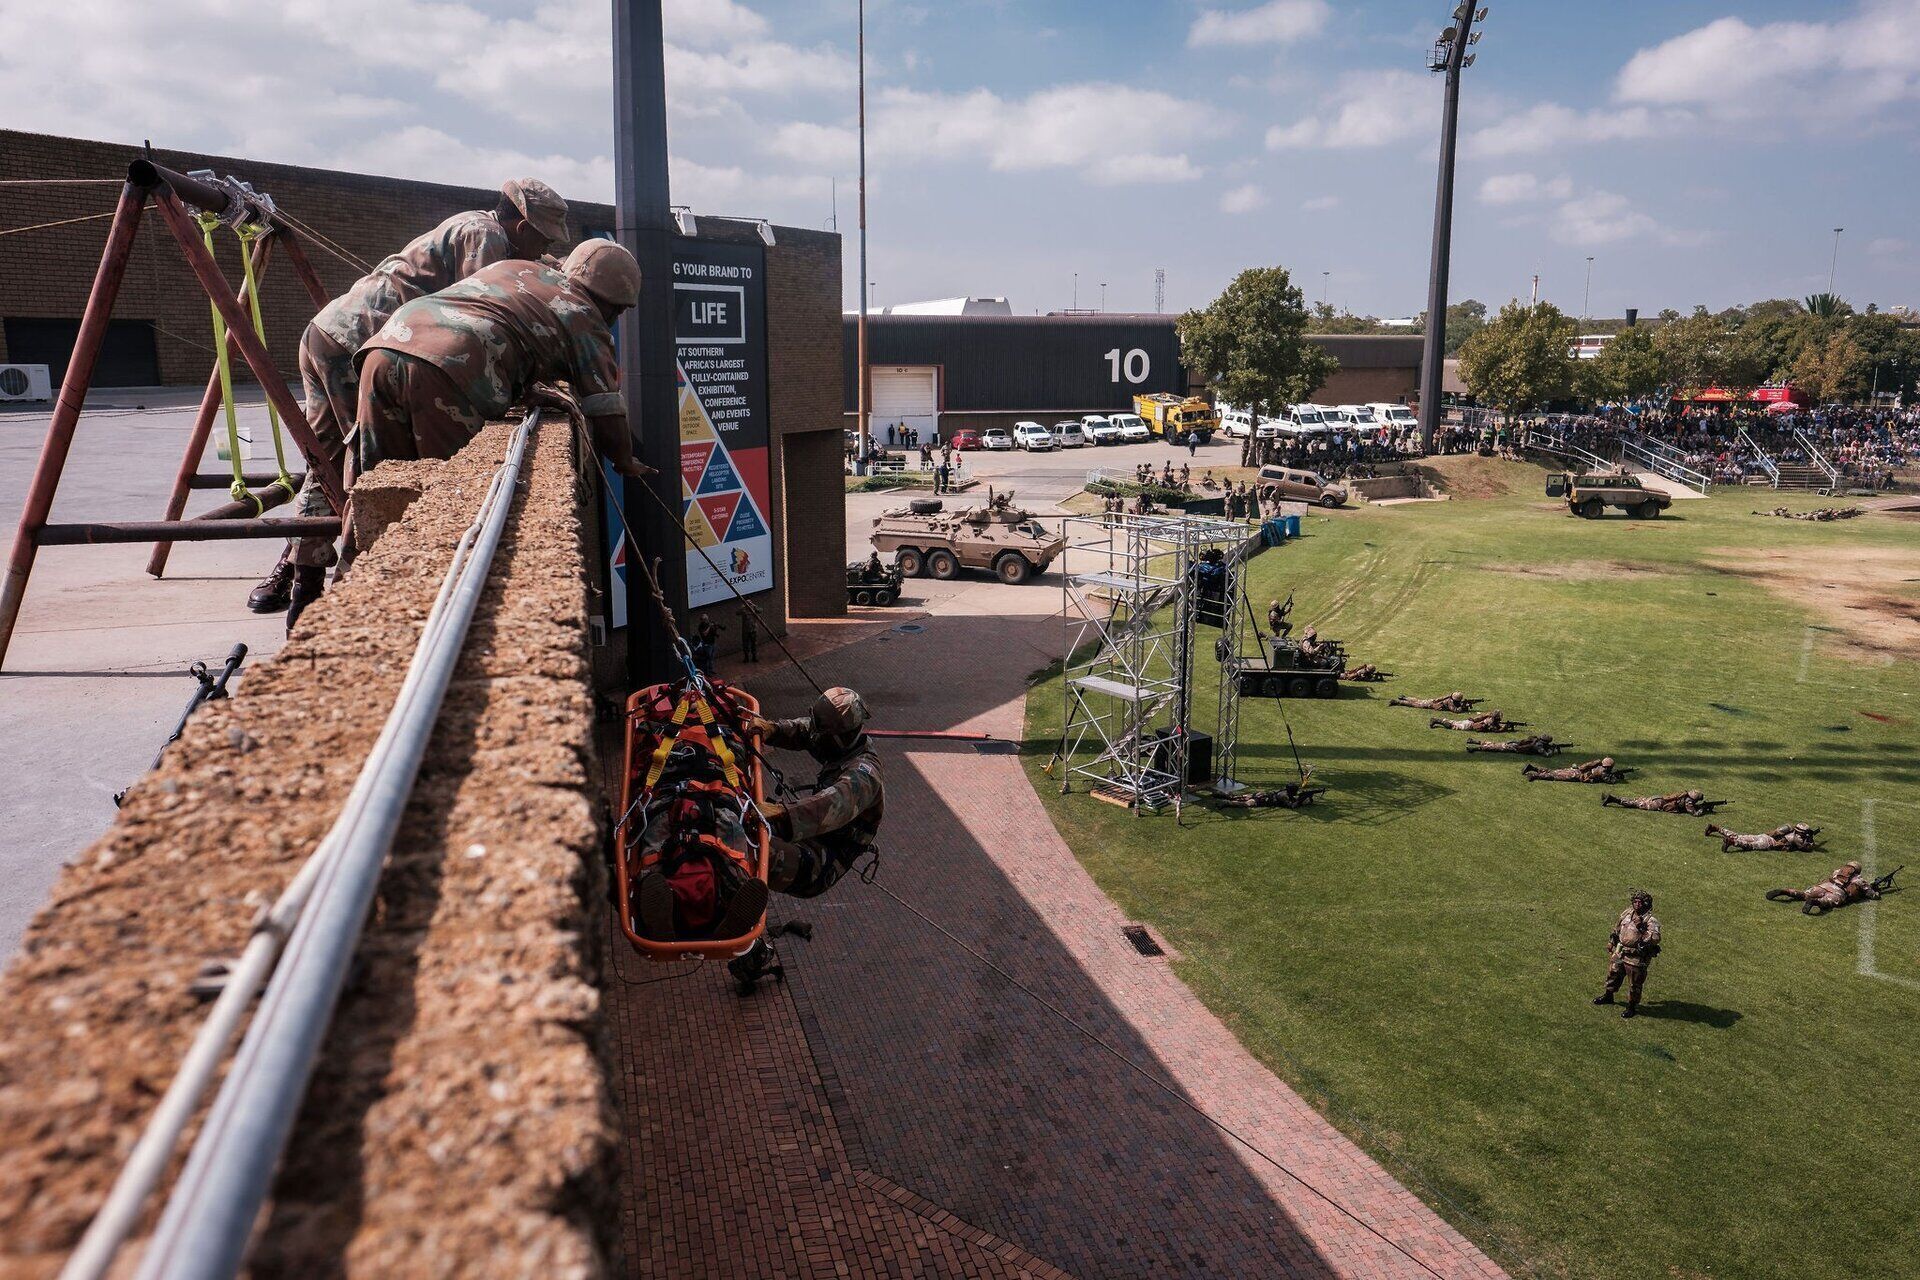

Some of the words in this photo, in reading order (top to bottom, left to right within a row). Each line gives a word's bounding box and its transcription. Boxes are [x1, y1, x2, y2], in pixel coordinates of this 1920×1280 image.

[682, 263, 708, 277] YOUR
[709, 265, 739, 278] BRAND
[740, 267, 752, 279] TO
[691, 301, 727, 324] LIFE
[677, 347, 687, 357] AT
[688, 347, 724, 357] SOUTHERN
[684, 360, 715, 370] AFRICA'S
[716, 359, 745, 369] LARGEST
[1104, 348, 1150, 384] 10
[691, 371, 749, 382] FULLY-CONTAINED
[698, 384, 737, 395] EXHIBITION,
[704, 396, 747, 407] CONFERENCE
[711, 410, 726, 420] AND
[726, 408, 751, 419] EVENTS
[717, 421, 740, 432] VENUE
